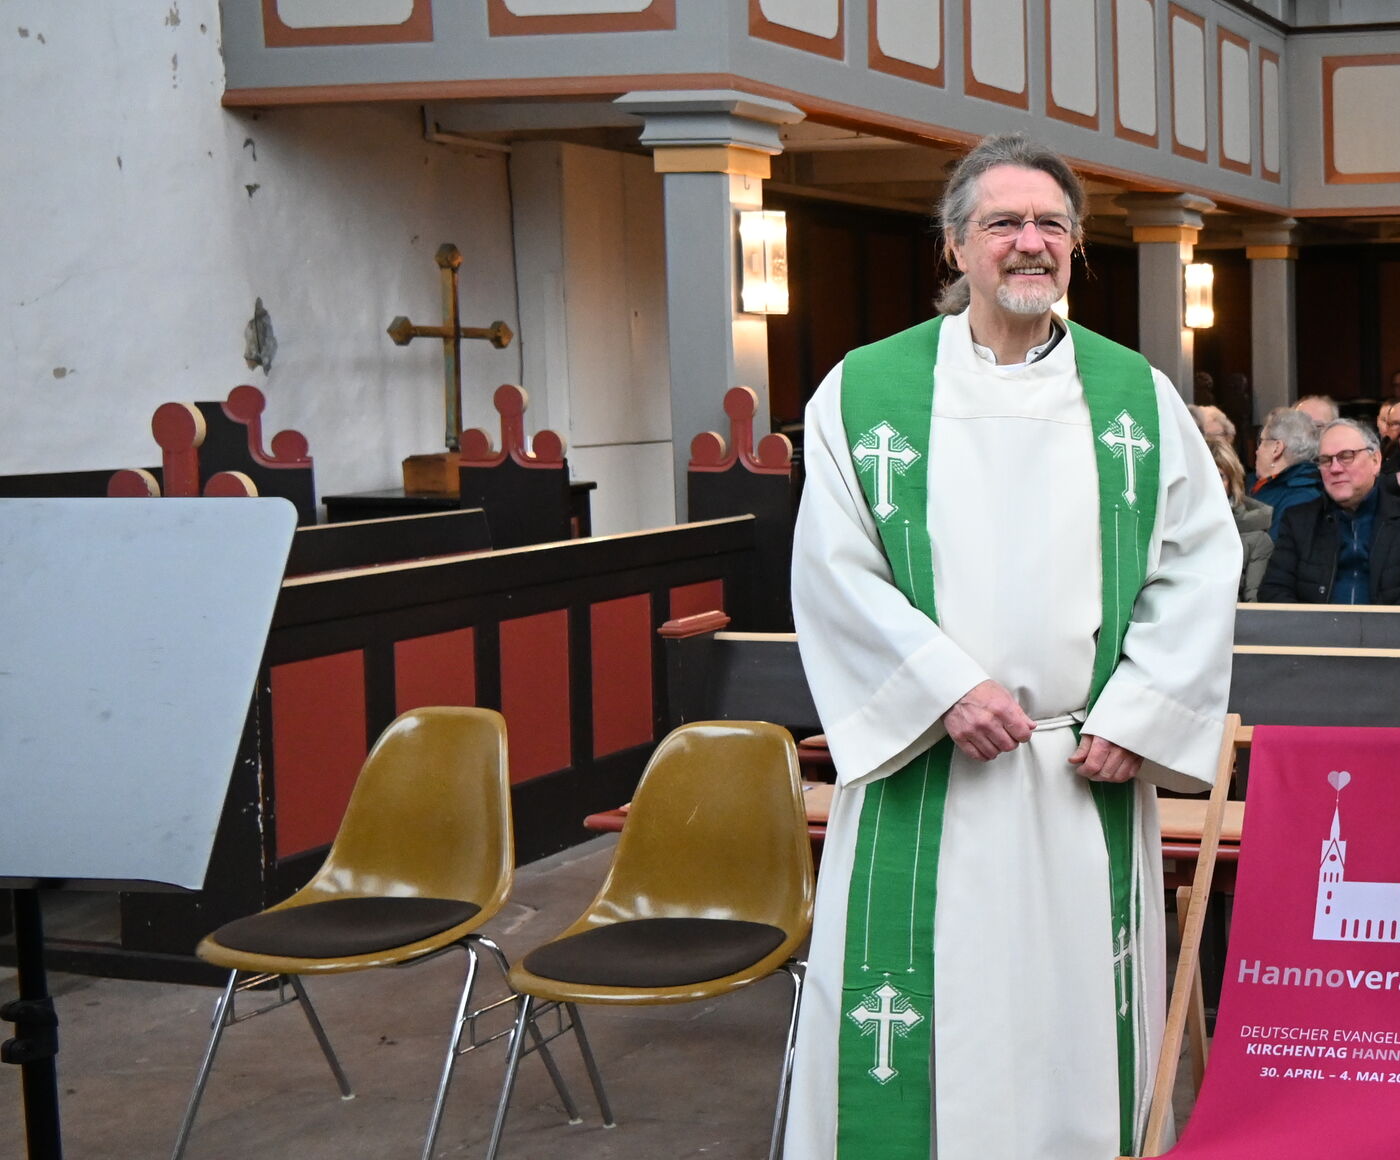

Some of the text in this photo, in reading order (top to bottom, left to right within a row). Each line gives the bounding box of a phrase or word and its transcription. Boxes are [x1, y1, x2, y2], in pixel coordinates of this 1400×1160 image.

[1240, 1025, 1329, 1041] DEUTSCHER
[1246, 1043, 1348, 1059] KIRCHENTAG
[1260, 1066, 1280, 1078] 30.
[1284, 1068, 1325, 1080] APRIL
[1340, 1071, 1352, 1081] 4.
[1356, 1071, 1385, 1083] MAI
